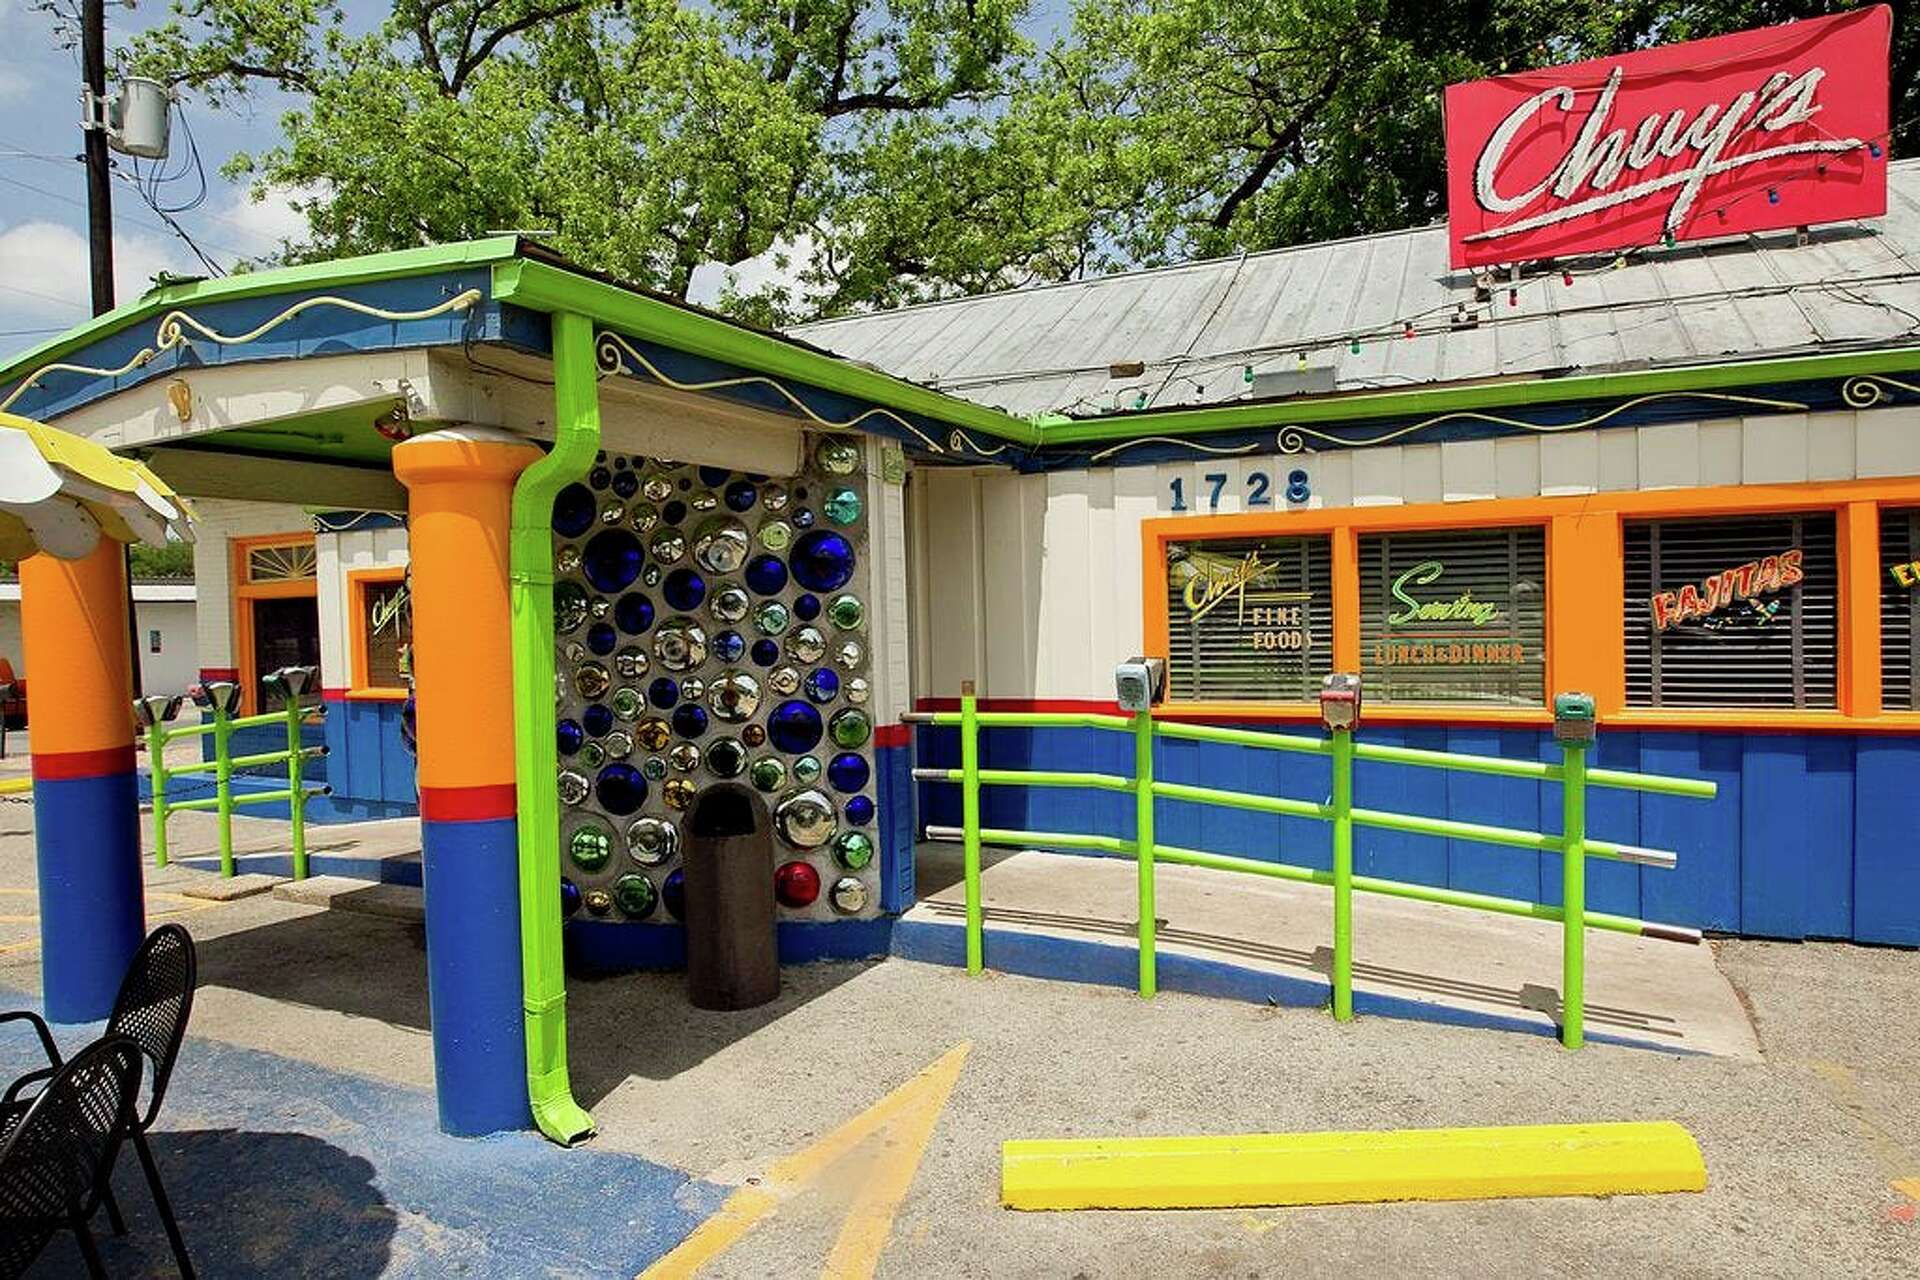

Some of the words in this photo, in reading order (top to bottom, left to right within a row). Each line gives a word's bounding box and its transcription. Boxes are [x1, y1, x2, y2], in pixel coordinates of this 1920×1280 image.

[1462, 66, 1864, 242] Chuy's
[1170, 470, 1311, 511] 1728
[1252, 606, 1301, 626] FINE
[1389, 561, 1497, 626] Serving
[1652, 550, 1805, 631] FAJITAS
[1252, 631, 1312, 650] FOODS
